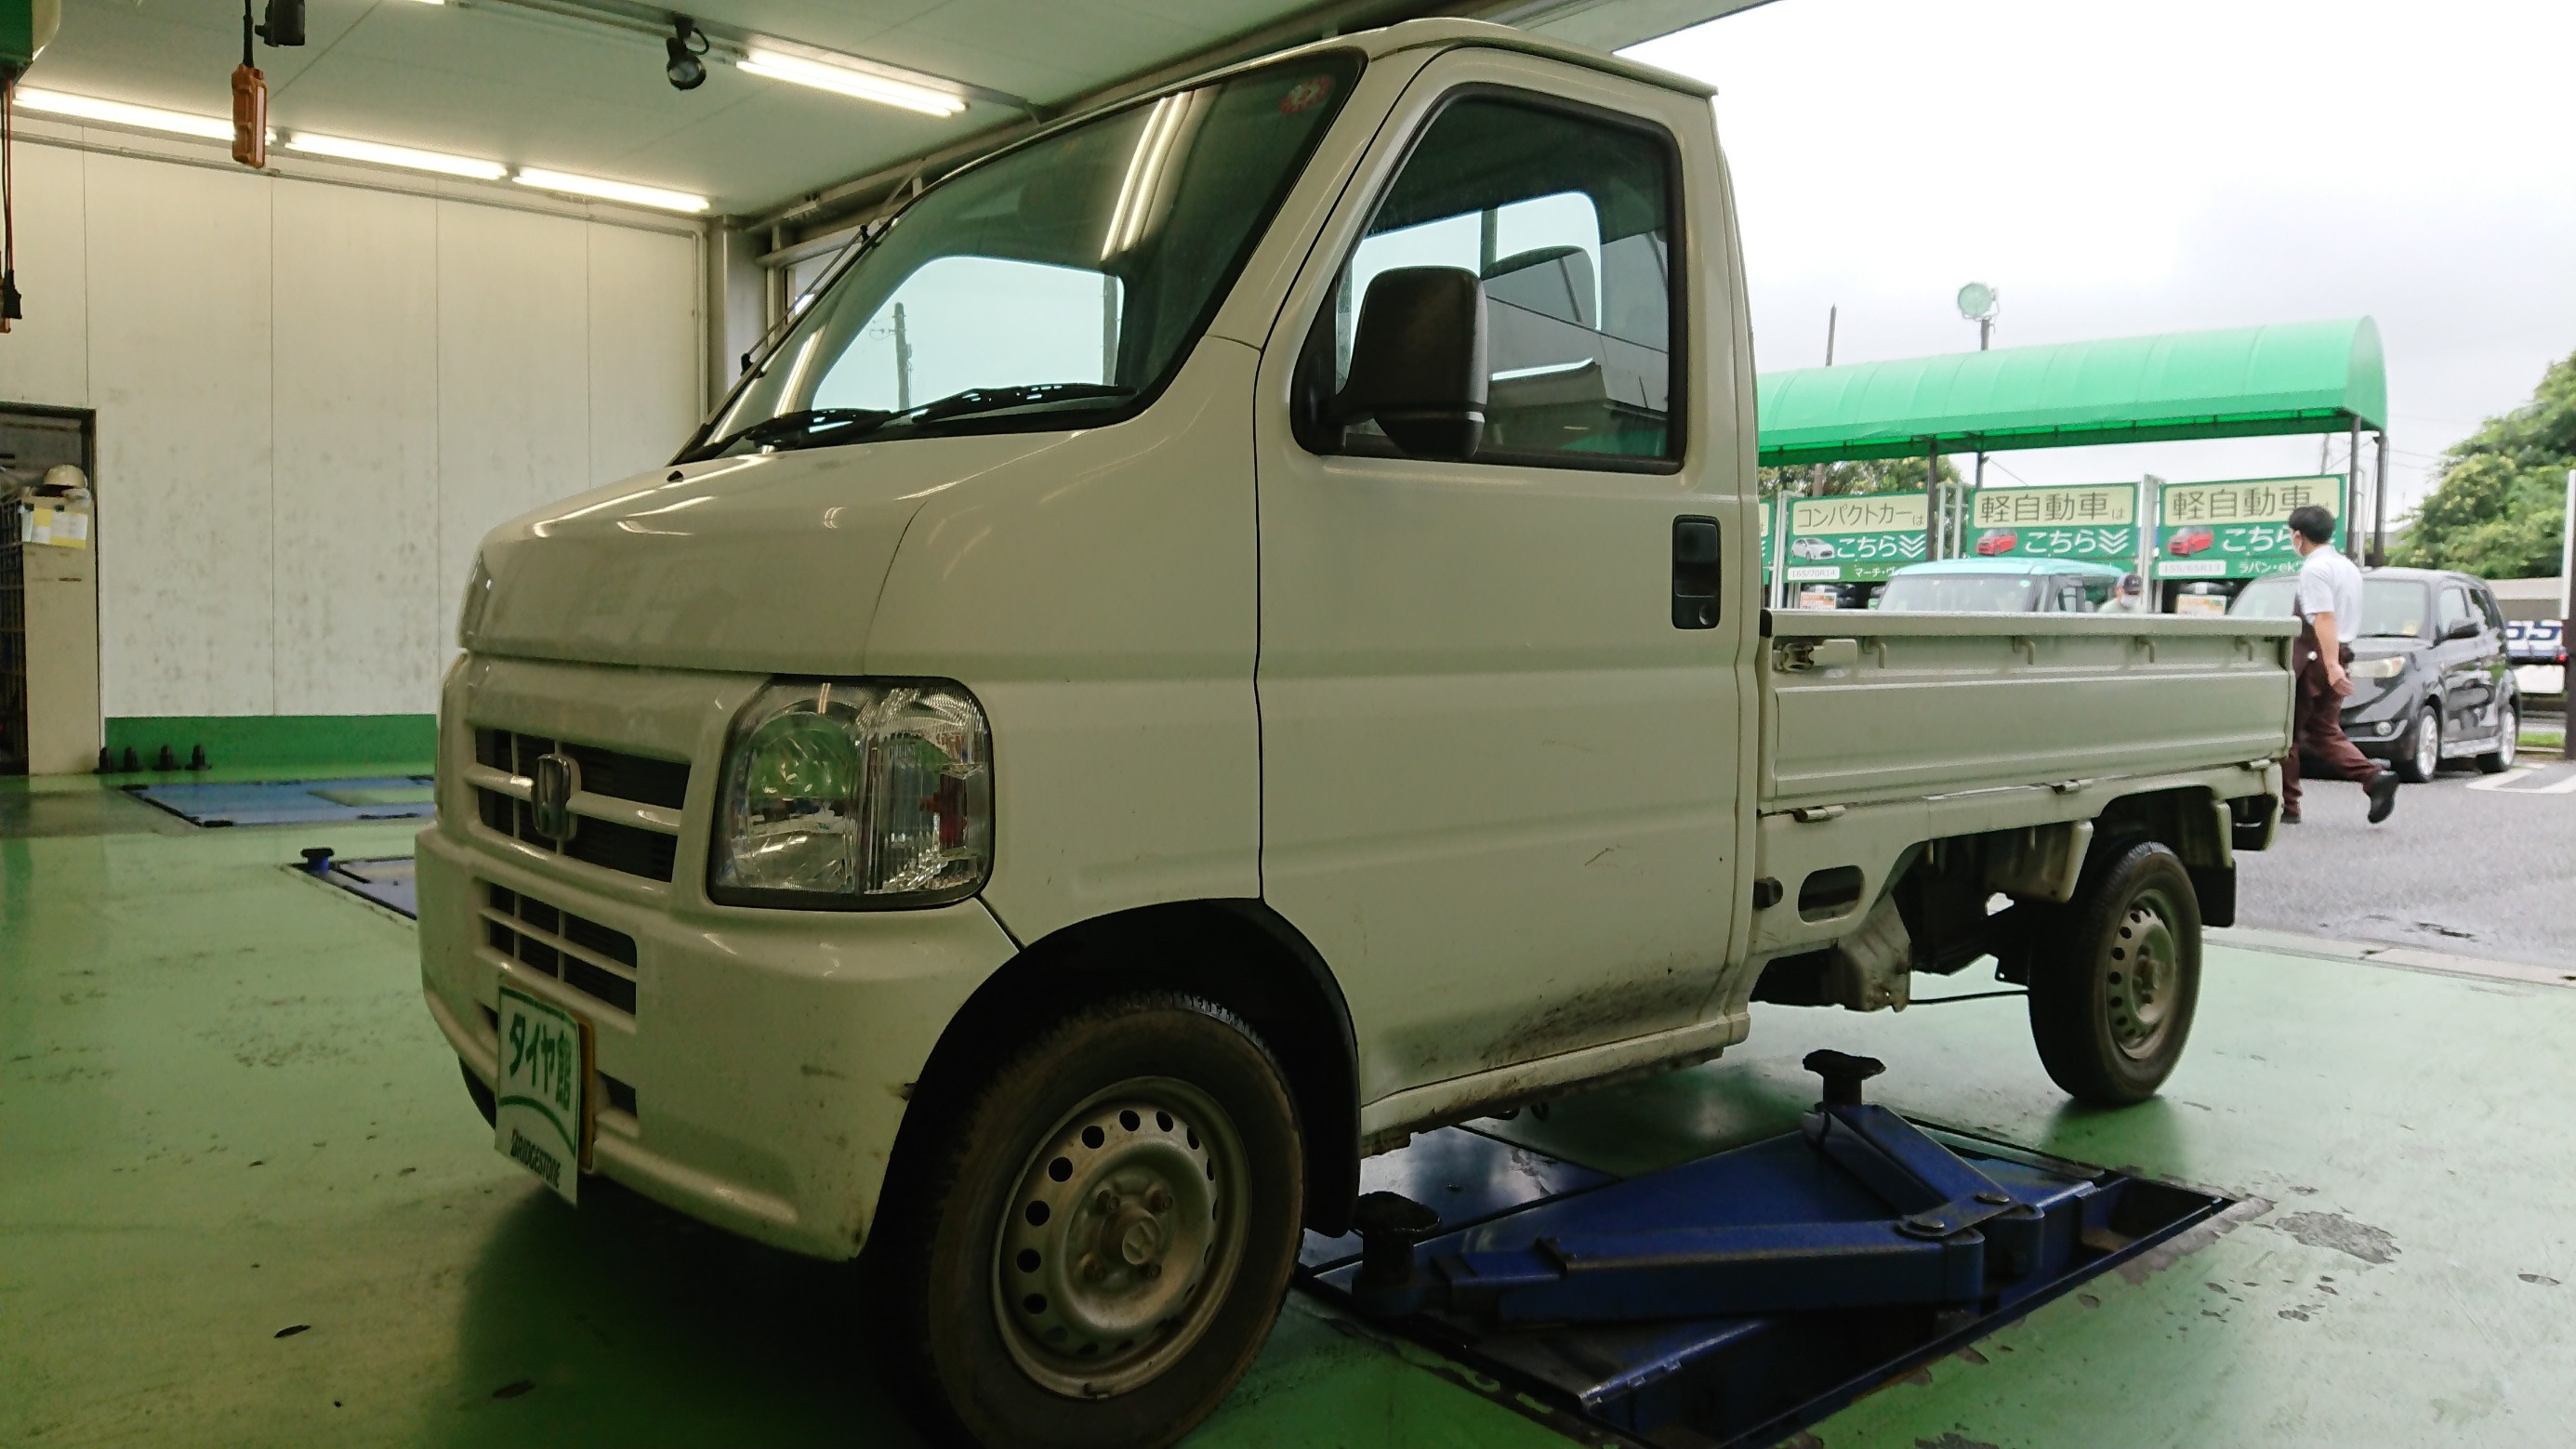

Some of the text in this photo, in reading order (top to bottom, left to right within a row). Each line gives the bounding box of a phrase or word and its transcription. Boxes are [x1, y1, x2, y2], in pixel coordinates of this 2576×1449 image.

[1797, 502, 1925, 529] コンパクトカーは
[1980, 492, 2125, 523] 軽自動車は
[1837, 534, 1897, 559] こちら
[2025, 529, 2097, 554] こちら
[1791, 569, 1836, 579] 165/70R14
[509, 1011, 572, 1111] タイヤ館
[510, 1128, 561, 1190] BRIDGESTONE
